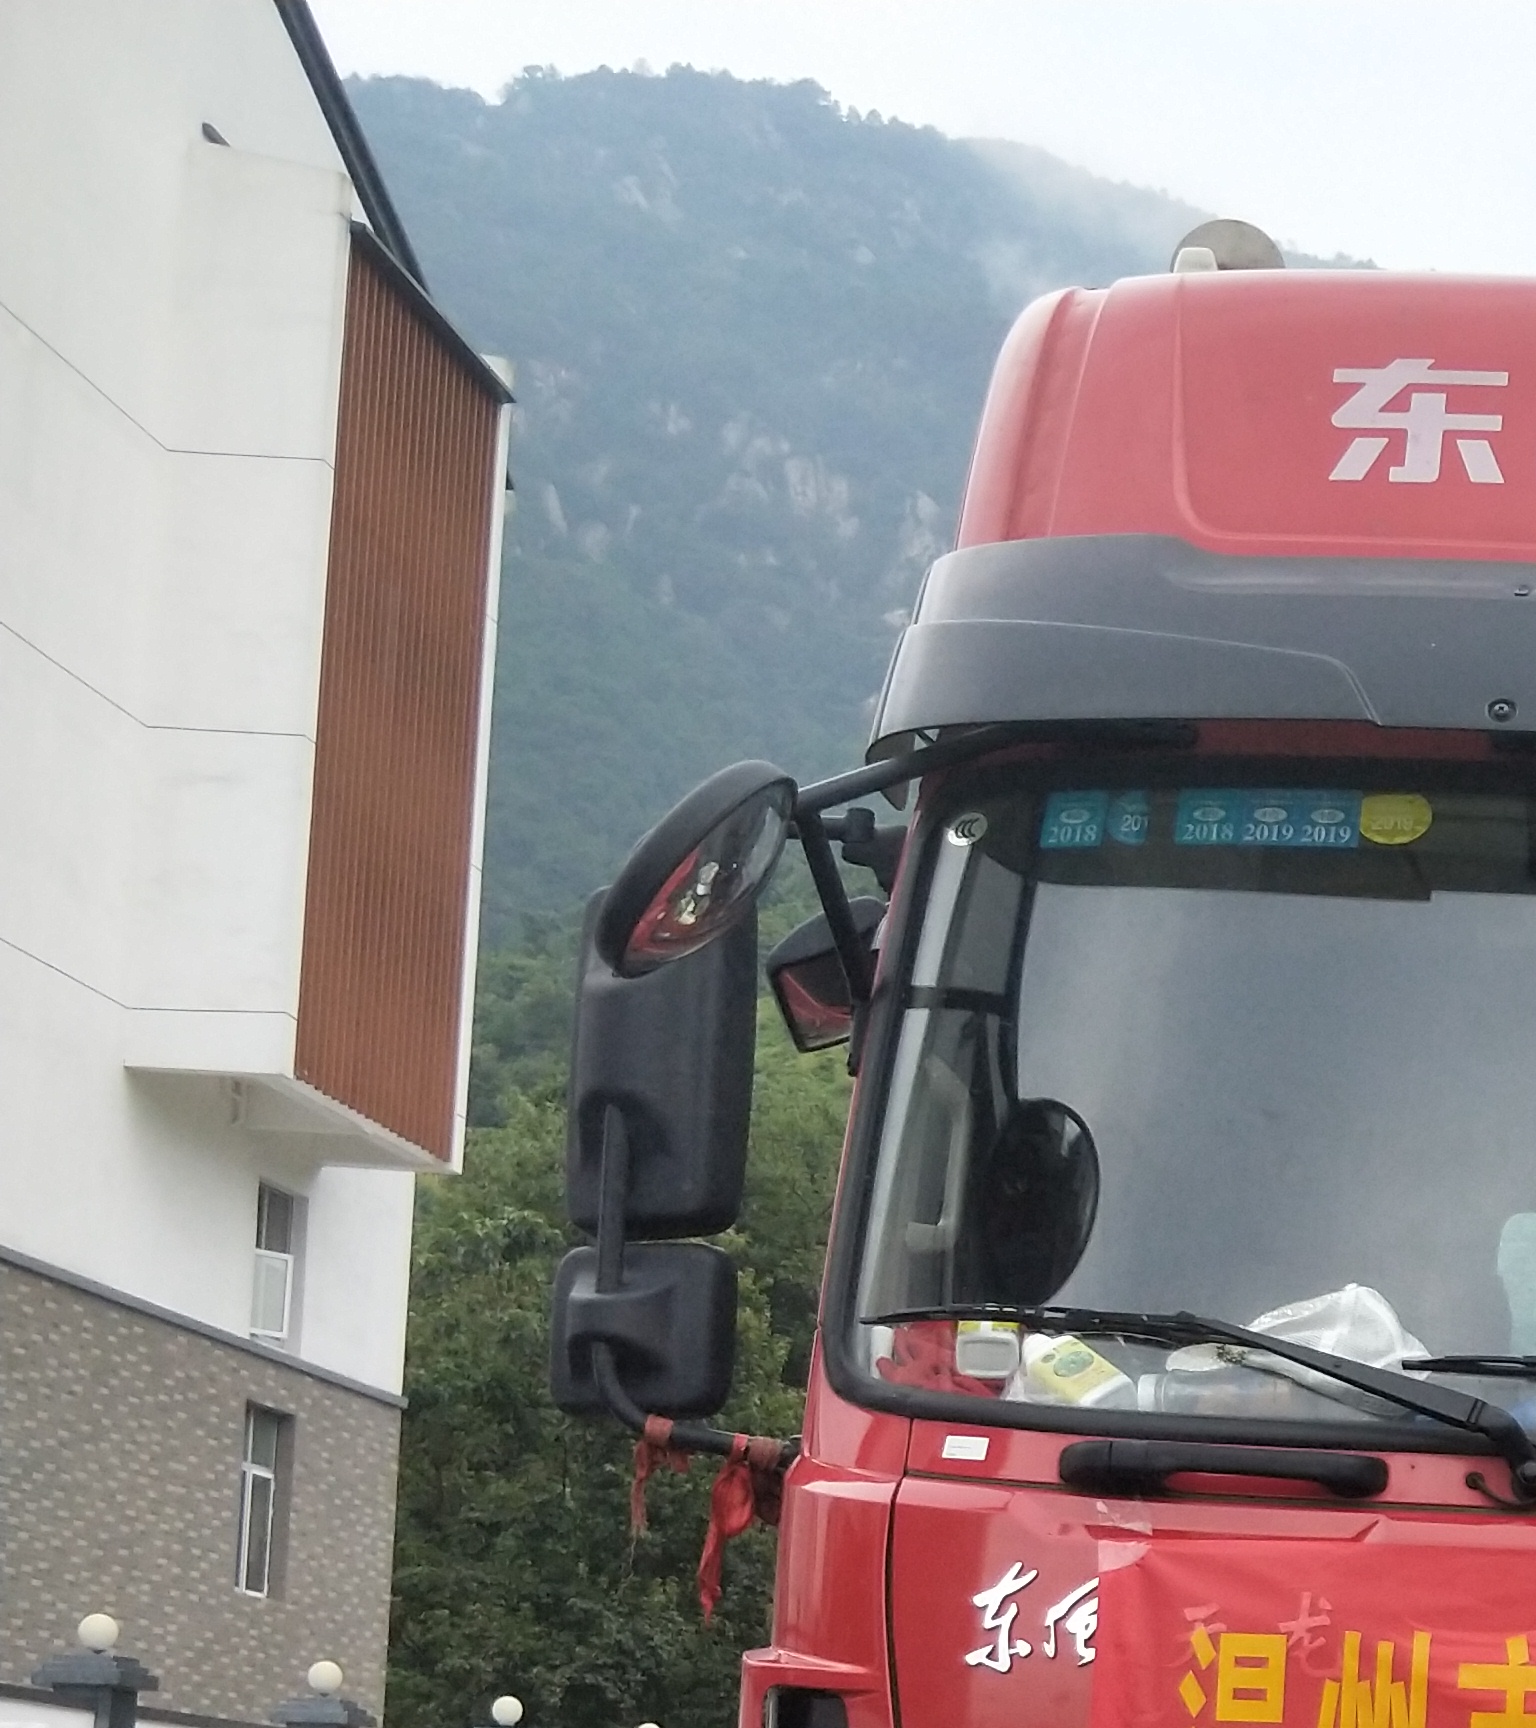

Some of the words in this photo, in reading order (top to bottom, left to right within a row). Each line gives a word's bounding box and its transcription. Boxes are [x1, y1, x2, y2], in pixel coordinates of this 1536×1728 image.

[1047, 823, 1098, 843] 2018
[1182, 822, 1235, 842] 2018
[1242, 823, 1295, 843] 2019
[1301, 824, 1352, 843] 2019
